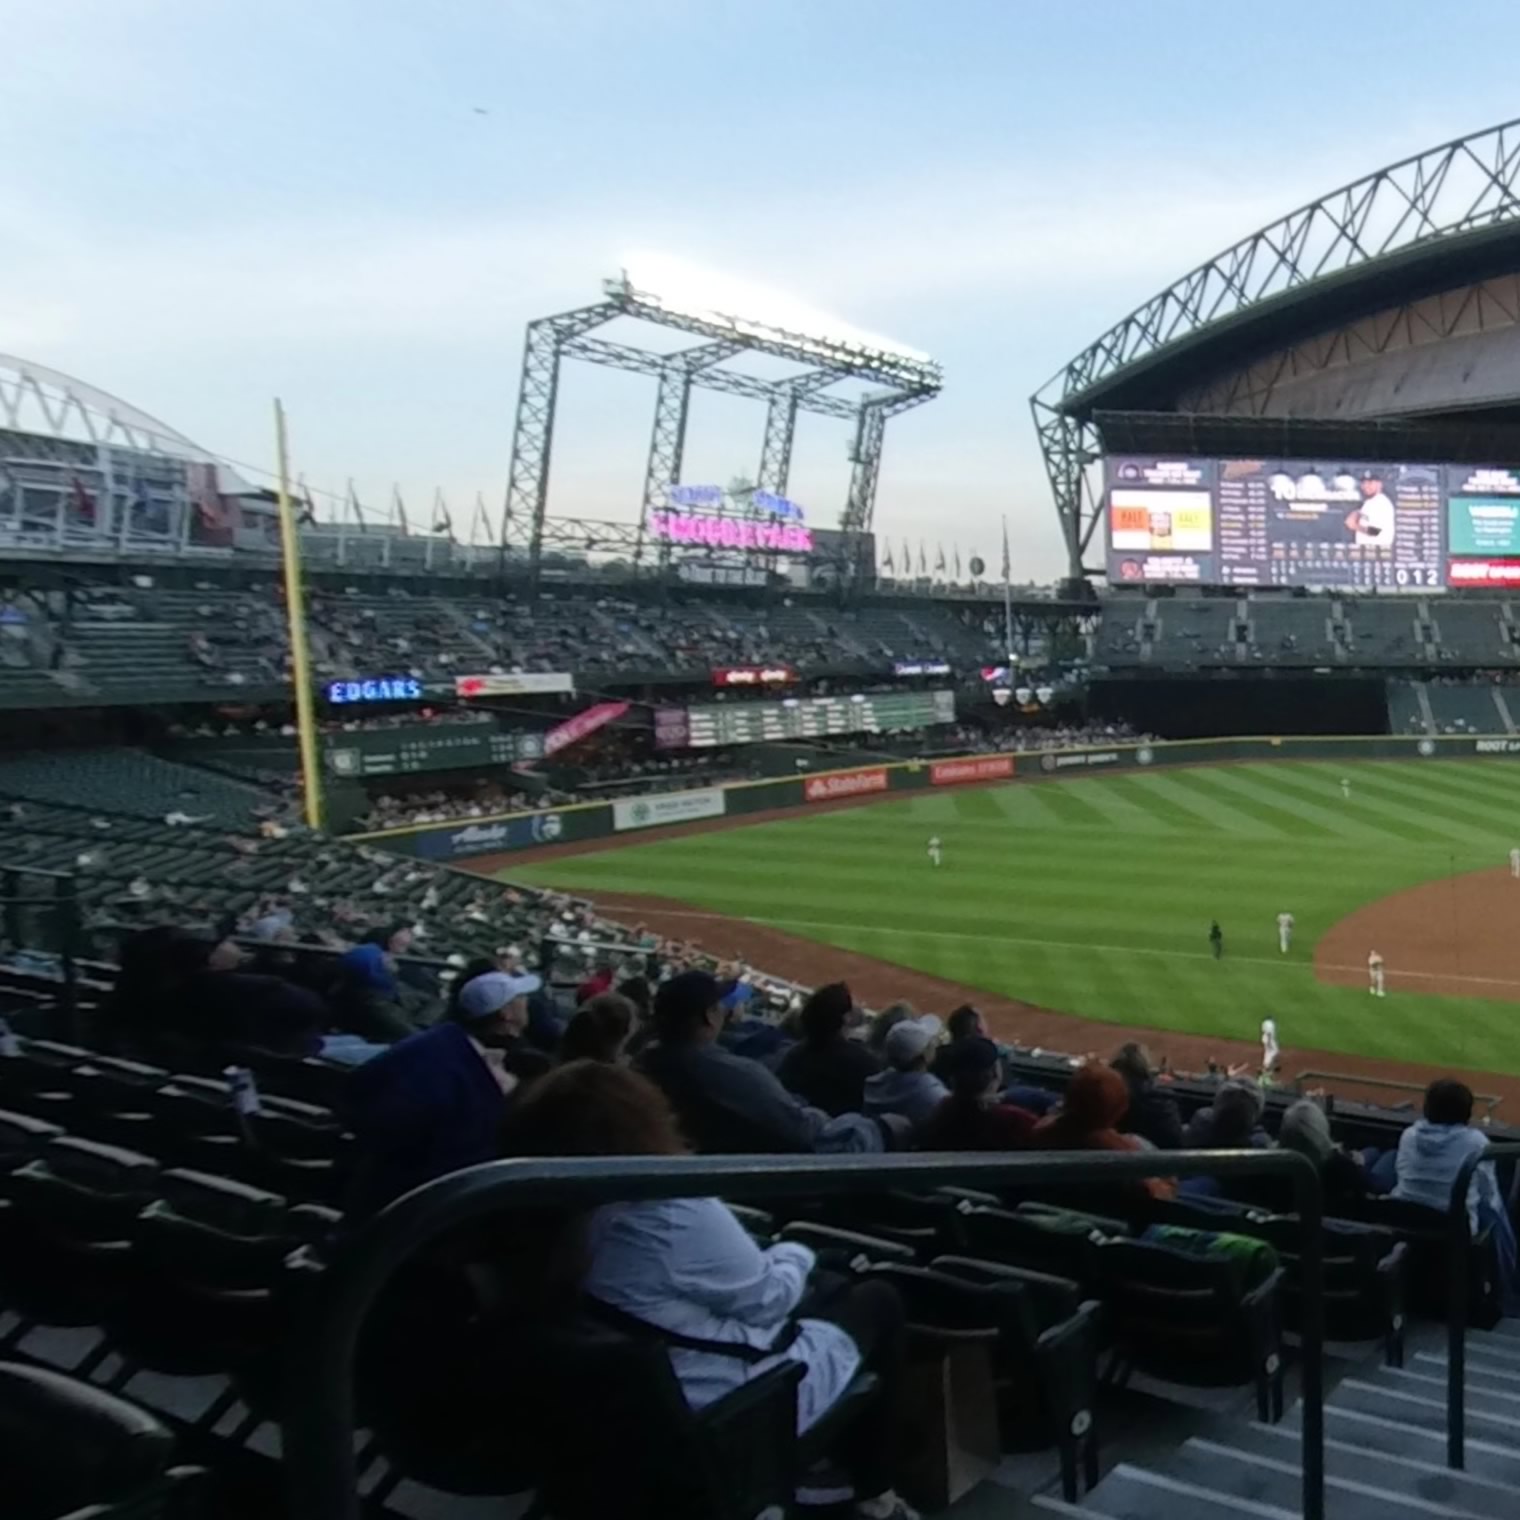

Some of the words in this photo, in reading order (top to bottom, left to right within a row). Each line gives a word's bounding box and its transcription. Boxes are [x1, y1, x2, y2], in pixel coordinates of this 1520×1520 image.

[1396, 569, 1408, 585] 0
[1413, 569, 1422, 585] 1
[1427, 569, 1439, 585] 2
[330, 680, 422, 703] EDGARS
[1476, 740, 1508, 752] ROOT
